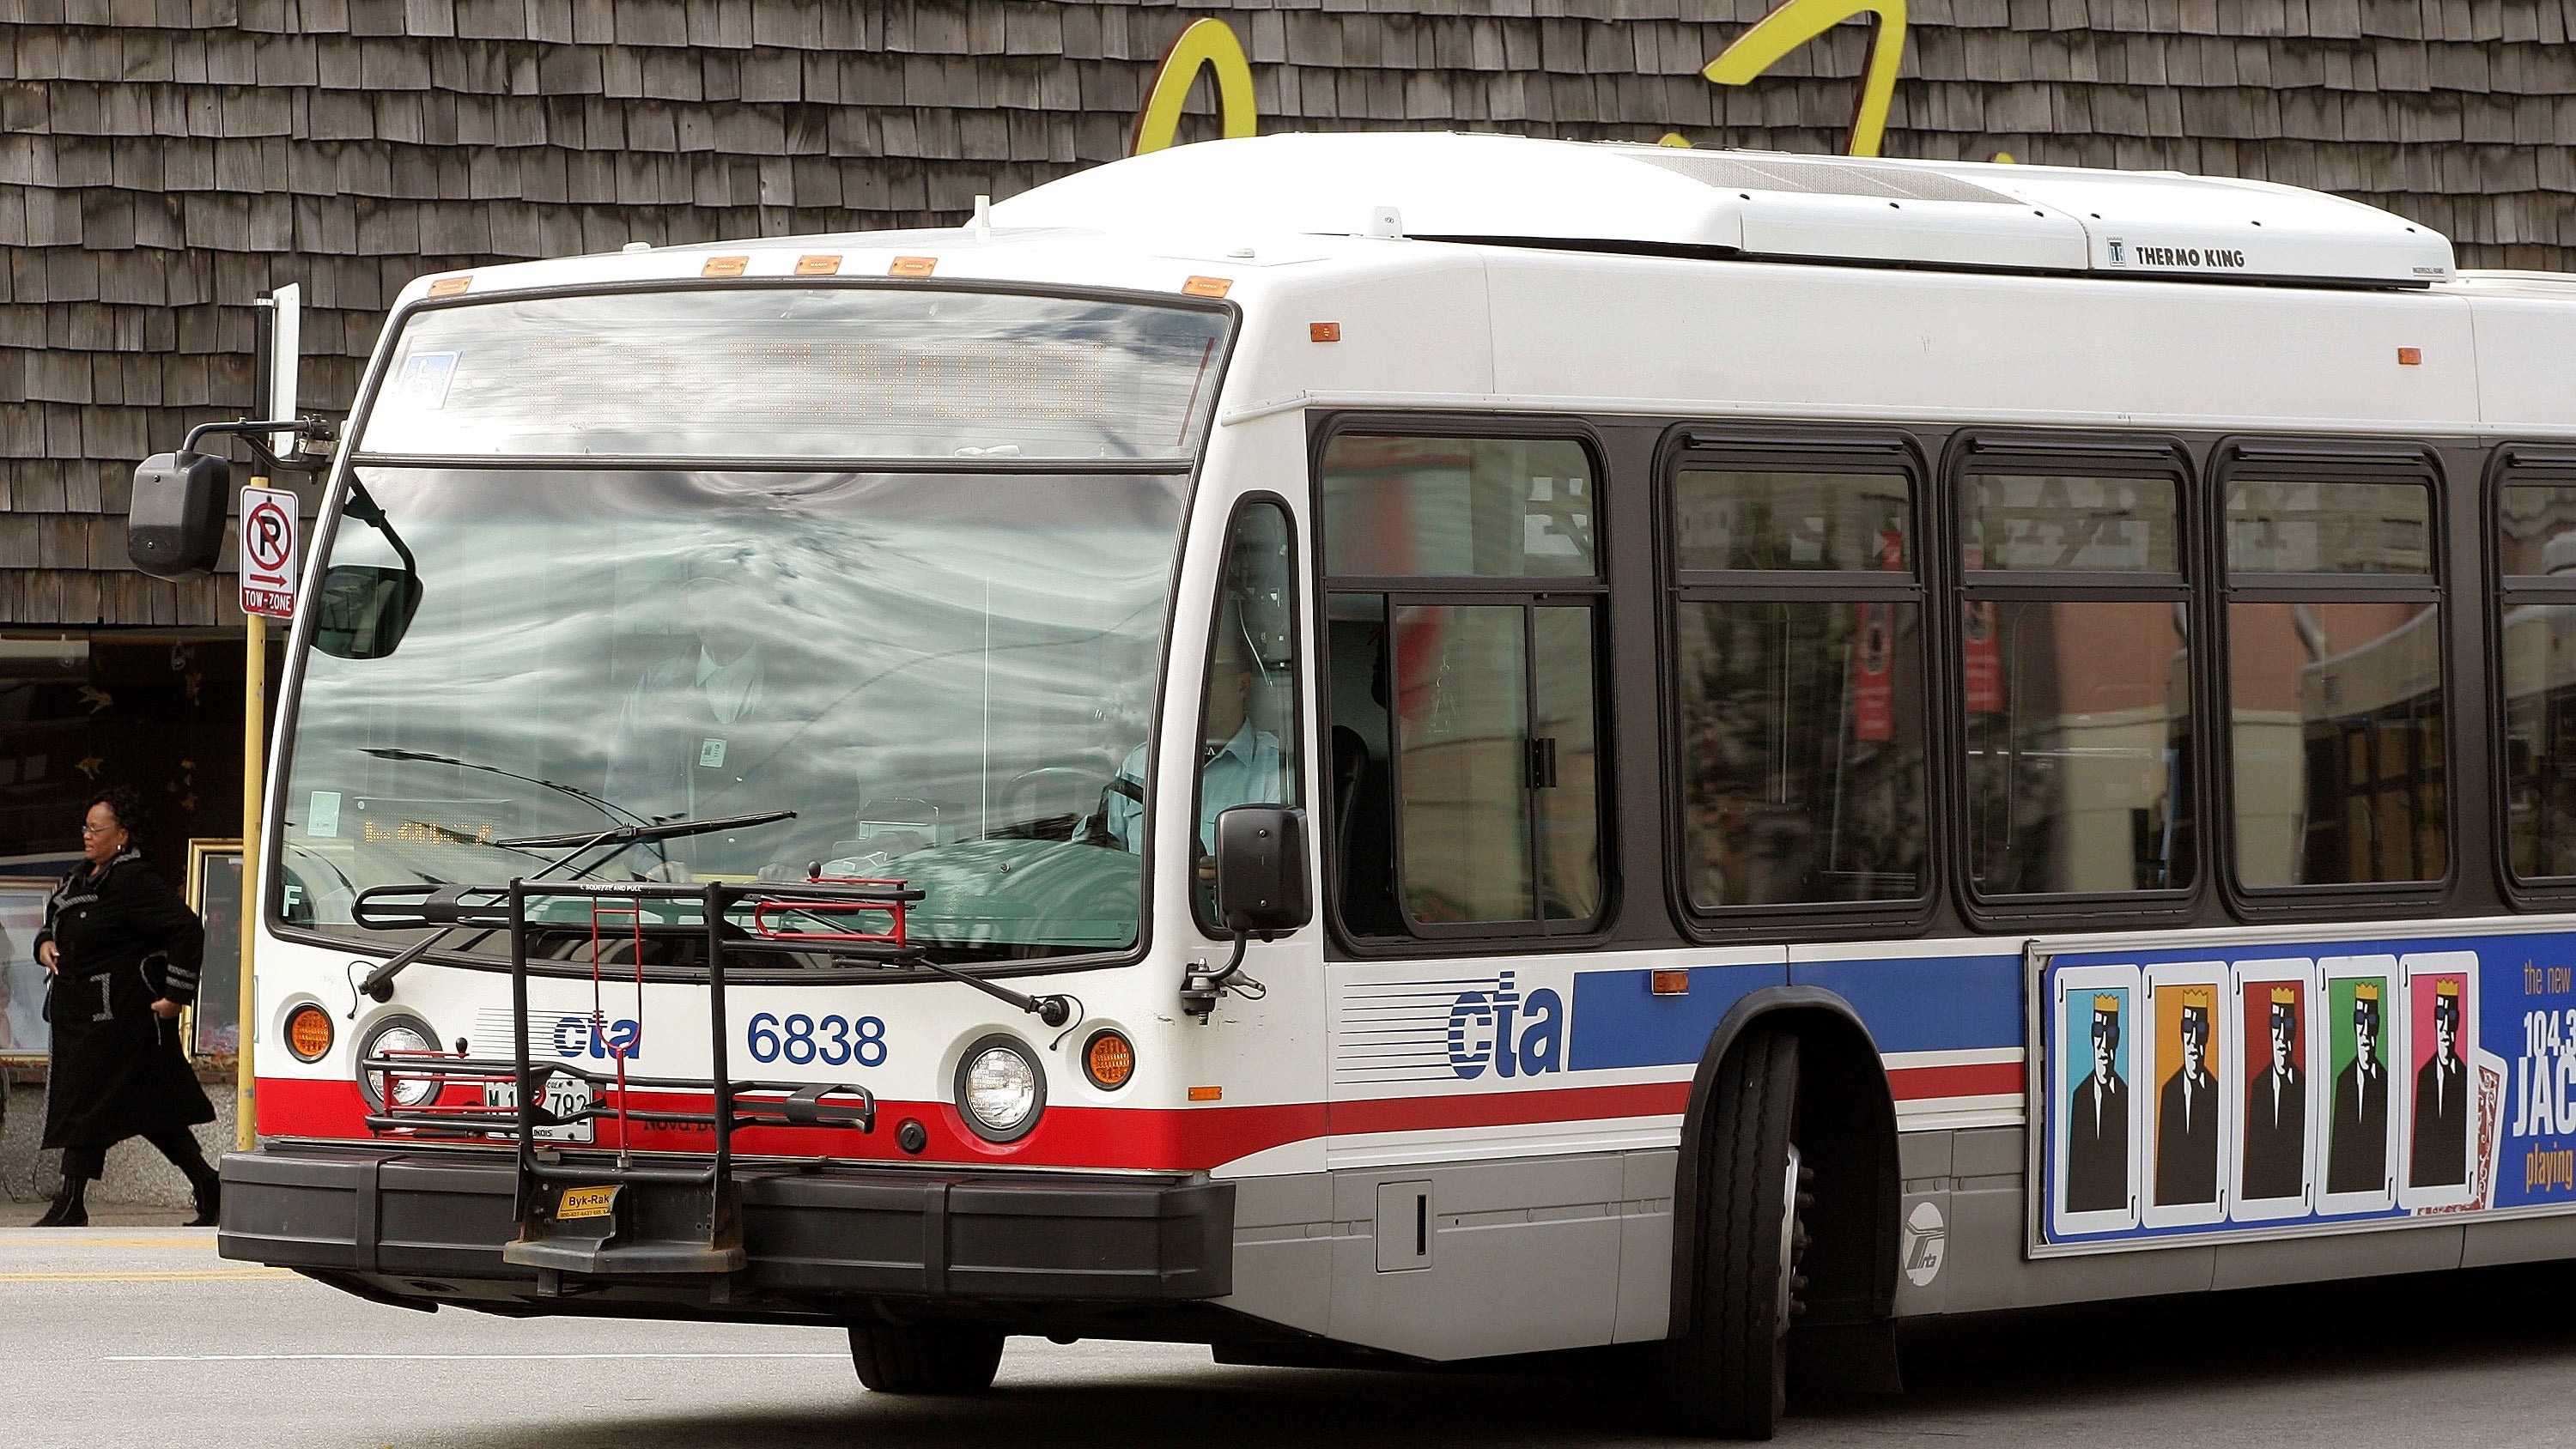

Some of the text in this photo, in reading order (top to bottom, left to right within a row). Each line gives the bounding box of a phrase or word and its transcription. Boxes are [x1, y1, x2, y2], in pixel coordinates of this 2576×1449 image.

[2136, 246, 2245, 268] THERMO KING
[245, 590, 292, 612] TOW-ZONE
[283, 885, 302, 917] F
[2147, 974, 2153, 999] J
[2236, 971, 2240, 995] J
[2321, 967, 2326, 991] J
[2403, 964, 2409, 987] J
[2524, 959, 2573, 996] the new
[2059, 978, 2064, 1004] J
[553, 1009, 641, 1059] cta
[1448, 970, 1564, 1081] cta
[2523, 1009, 2576, 1058] 104.3
[747, 1011, 889, 1068] 6838
[2525, 1140, 2574, 1193] playing
[568, 1194, 610, 1209] Byk-Rak
